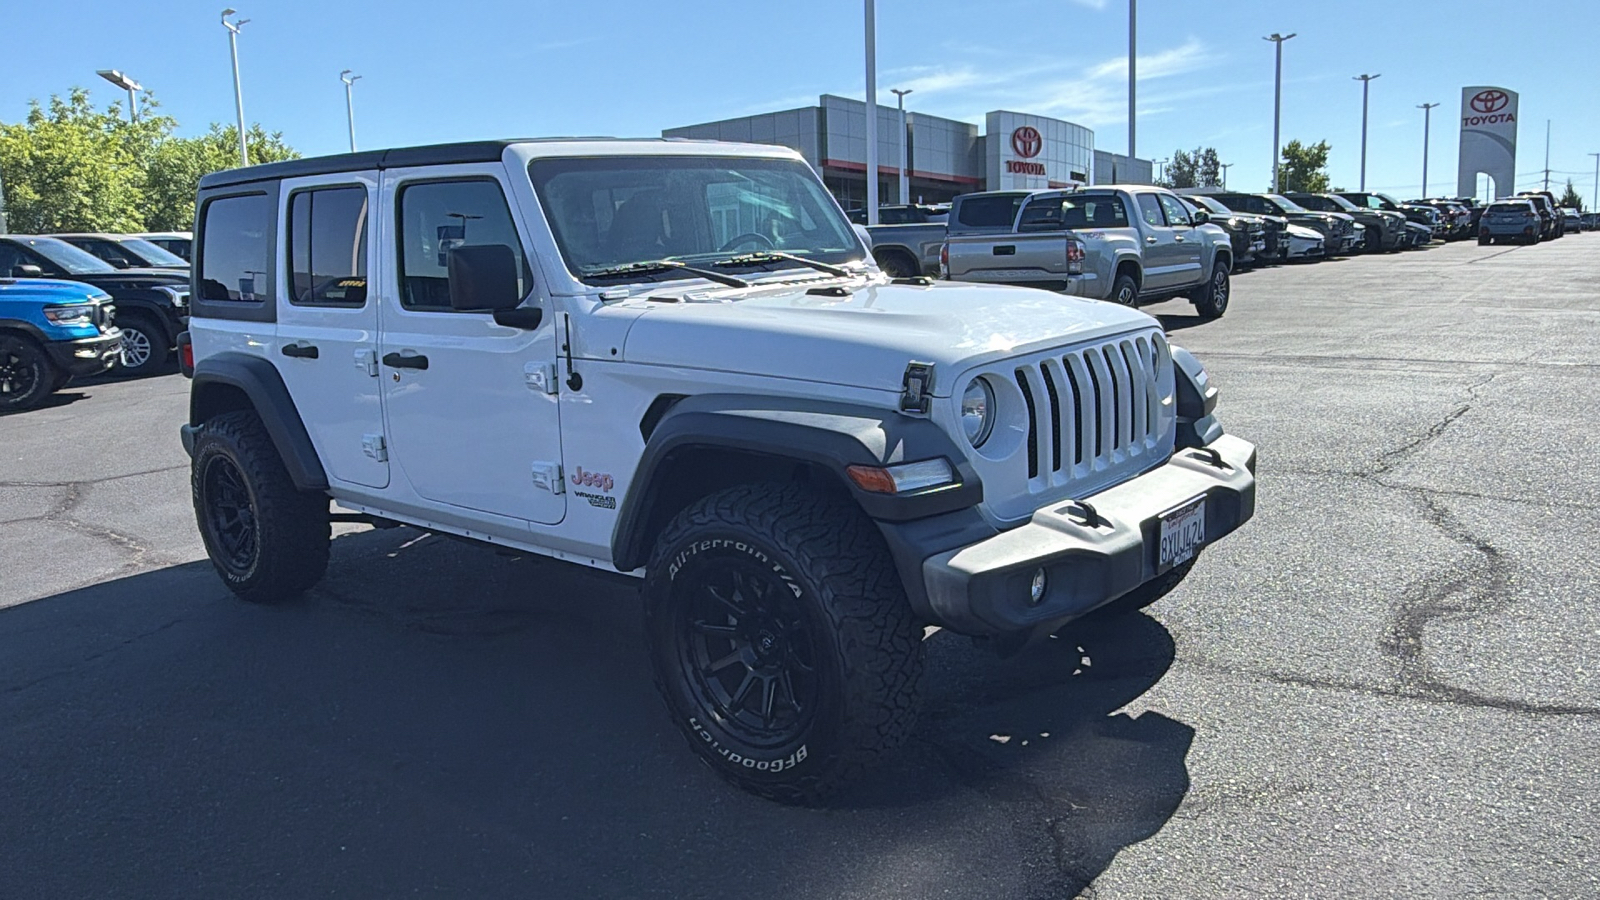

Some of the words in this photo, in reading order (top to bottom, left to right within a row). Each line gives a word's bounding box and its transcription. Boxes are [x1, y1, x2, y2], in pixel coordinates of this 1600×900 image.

[1463, 113, 1515, 127] TOYOTA
[1006, 160, 1046, 176] TOYOTA
[571, 466, 614, 493] Jeep
[574, 490, 615, 503] WRANGLER
[1161, 518, 1203, 563] 8XUJ424
[669, 538, 769, 581] All-Terrain
[772, 561, 803, 599] T/A
[689, 717, 808, 773] BFGoodrich
